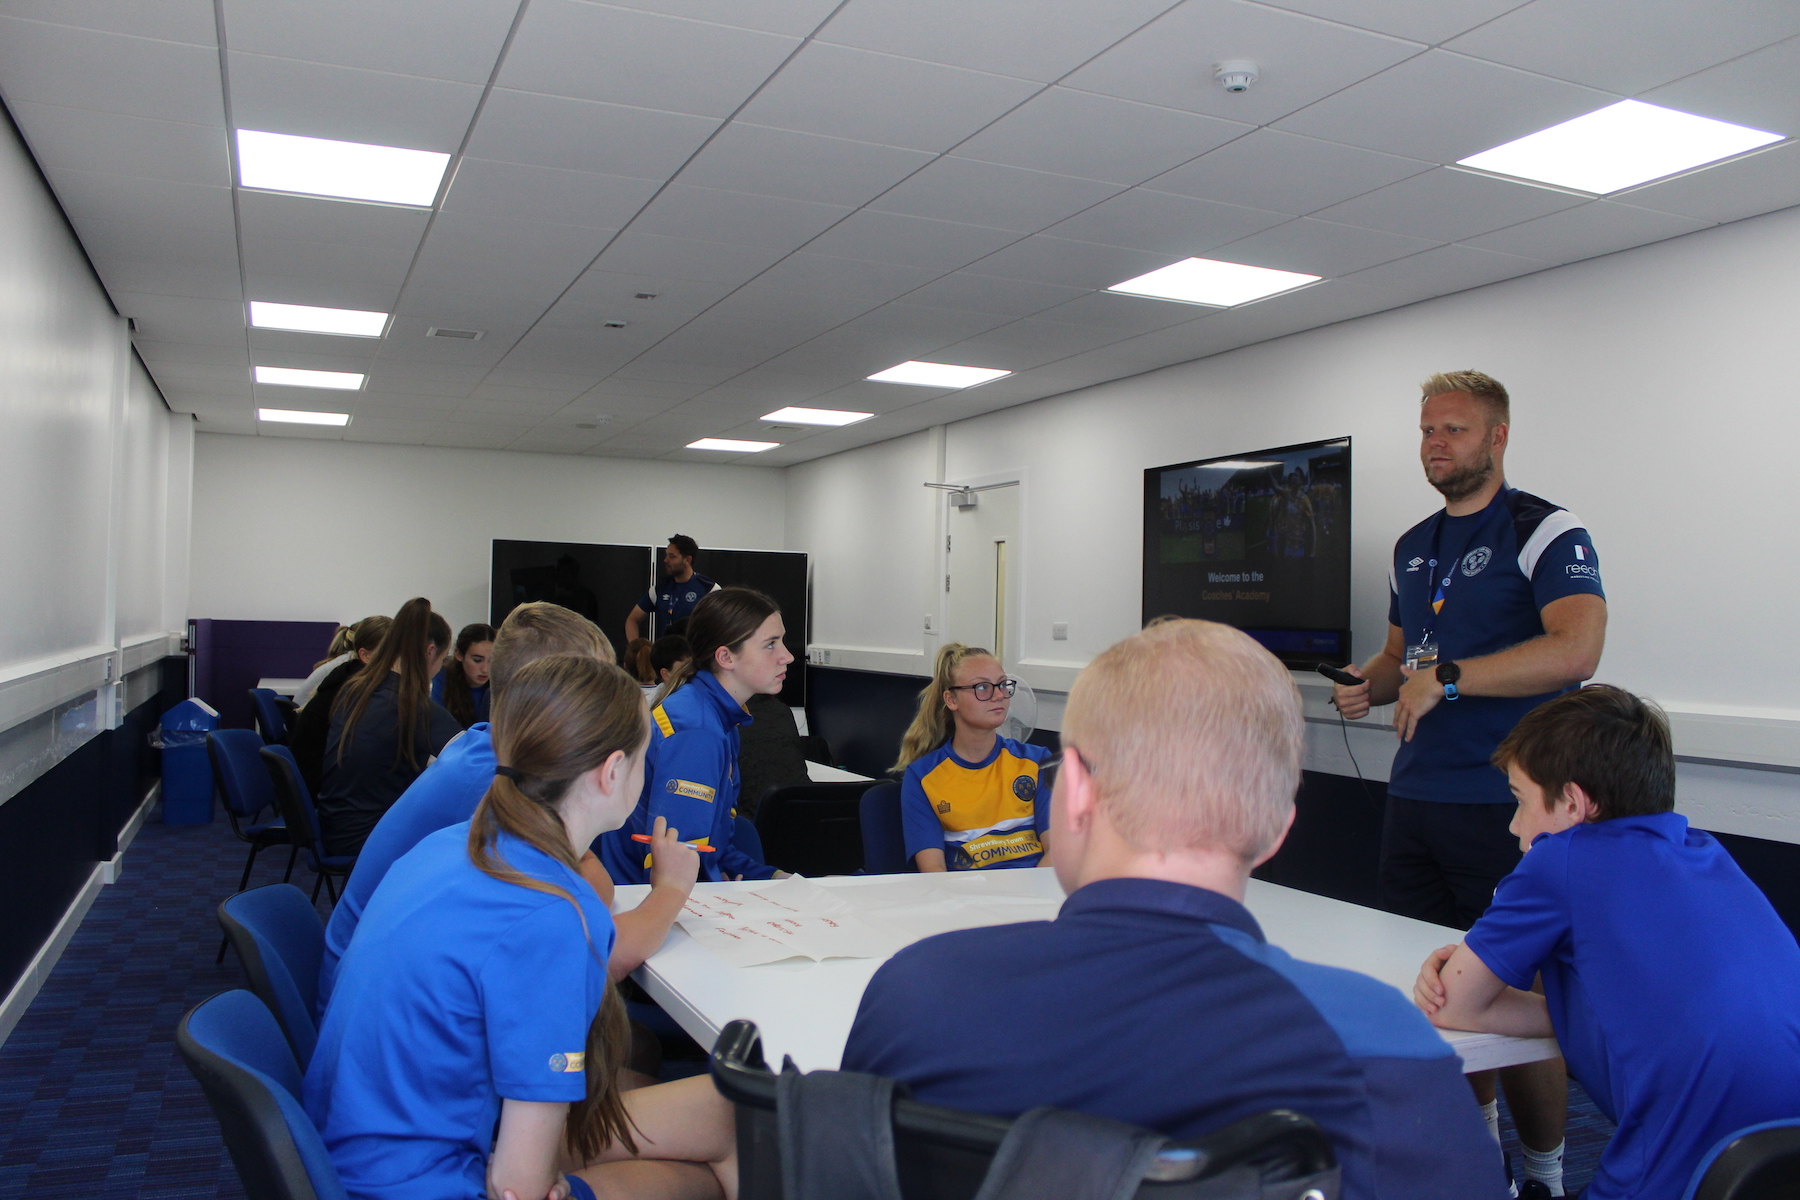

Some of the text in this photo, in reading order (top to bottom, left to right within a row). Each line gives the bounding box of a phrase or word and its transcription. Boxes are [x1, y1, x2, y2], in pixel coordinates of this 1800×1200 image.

[1207, 571, 1264, 583] Welcome to the
[1235, 590, 1271, 603] Academy
[969, 839, 1006, 851] Shrewsbury
[1006, 836, 1024, 845] Town
[972, 842, 1040, 863] COMMUNITY
